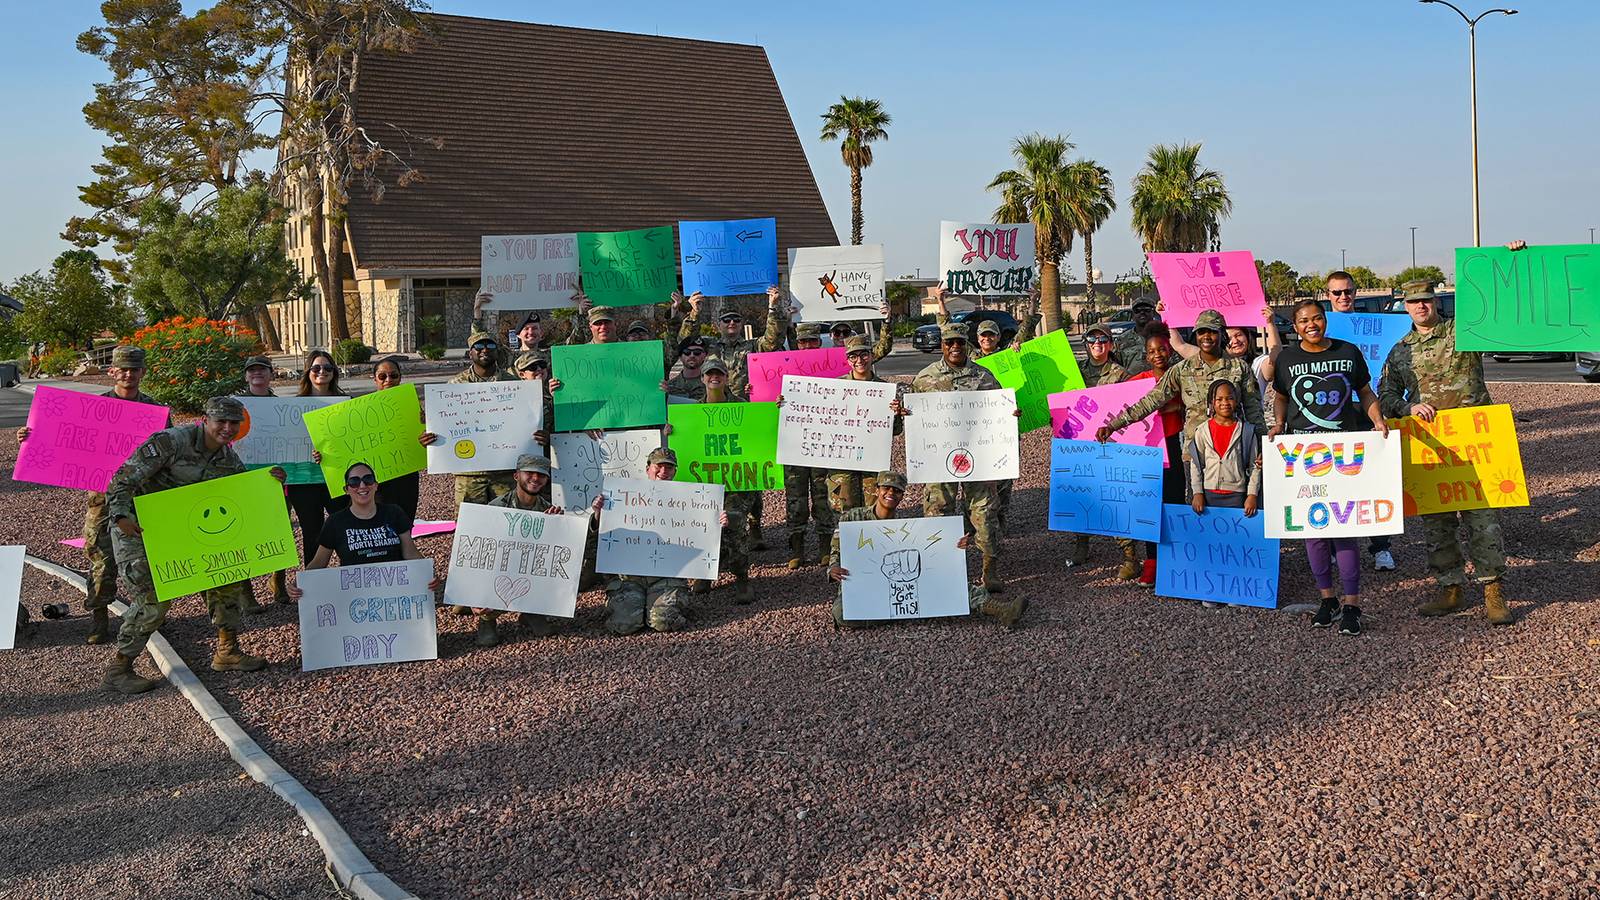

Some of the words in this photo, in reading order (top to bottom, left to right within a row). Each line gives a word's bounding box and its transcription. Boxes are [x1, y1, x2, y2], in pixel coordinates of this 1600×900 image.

[502, 238, 537, 261] YOU
[543, 238, 574, 260] ARE
[614, 232, 634, 249] U
[954, 228, 1019, 265] YOU
[608, 249, 644, 269] ARE
[703, 247, 760, 263] SUFFER
[583, 265, 673, 288] IMPORTANT
[841, 272, 872, 283] HANG
[1176, 256, 1226, 278] WE
[487, 272, 527, 293] NOT
[538, 271, 577, 291] ALONE
[696, 271, 711, 288] IN
[850, 283, 867, 292] IN
[947, 266, 1032, 294] MATTER
[1462, 253, 1590, 327] SMILE
[1180, 282, 1246, 308] CARE
[1351, 317, 1383, 336] YOU
[1360, 343, 1380, 360] RE
[614, 354, 661, 379] WORRY
[1288, 362, 1308, 377] YOU
[1311, 360, 1353, 374] MATTER
[503, 384, 521, 393] that
[789, 381, 801, 392] I
[807, 382, 836, 399] Hope
[842, 388, 860, 400] you
[866, 388, 885, 398] are
[79, 398, 123, 424] YOU
[438, 410, 458, 418] There
[598, 393, 648, 419] HAPPY
[789, 401, 848, 417] Surrounded
[856, 403, 869, 418] by
[920, 398, 929, 412] It
[969, 397, 998, 410] matter
[327, 402, 395, 438] GOOD
[702, 405, 745, 428] YOU
[785, 414, 813, 427] people
[819, 416, 839, 426] who
[844, 419, 860, 427] are
[867, 416, 890, 433] good
[921, 418, 939, 429] how
[944, 417, 961, 428] slow
[965, 421, 978, 431] you
[982, 419, 993, 429] go
[1472, 411, 1489, 434] A
[55, 422, 99, 453] ARE
[344, 428, 396, 454] VIBES
[449, 427, 472, 437] YOUER
[830, 433, 856, 446] your
[704, 433, 742, 456] ARE
[942, 441, 952, 449] as
[957, 441, 970, 450] you
[1096, 445, 1113, 459] I
[1276, 441, 1365, 477] YOU
[1422, 442, 1493, 471] GREAT
[689, 460, 776, 491] STRONG
[1073, 463, 1095, 476] AM
[1105, 466, 1138, 482] HERE
[618, 490, 652, 508] Take
[657, 500, 663, 508] a
[668, 498, 687, 510] deep
[691, 498, 719, 511] breath
[1100, 486, 1127, 501] FOR
[1297, 484, 1328, 498] ARE
[1438, 480, 1483, 505] DAY
[504, 512, 545, 540] YOU
[641, 516, 656, 528] just
[672, 519, 685, 528] bad
[691, 520, 707, 533] day
[1079, 501, 1132, 533] YOU
[1284, 499, 1394, 532] LOVED
[345, 527, 369, 537] EVERY
[370, 525, 387, 535] LIFE
[347, 535, 356, 544] IS
[357, 534, 362, 542] A
[363, 531, 388, 541] STORY
[1213, 516, 1250, 538] OK
[348, 540, 374, 551] WORTH
[657, 537, 671, 546] bad
[679, 537, 694, 548] life
[156, 559, 198, 582] MAKE
[201, 547, 249, 571] SOMEONE
[255, 538, 288, 557] SMILE
[456, 534, 571, 579] MATTER
[1167, 541, 1197, 561] TO
[1208, 542, 1270, 569] MAKE
[207, 567, 251, 586] TODAY
[340, 565, 410, 590] HAVE
[1171, 568, 1275, 601] MISTAKES
[896, 591, 914, 602] Got
[316, 602, 337, 627] A
[349, 594, 428, 624] GREAT
[892, 602, 919, 615] This!
[342, 633, 398, 662] DAY
